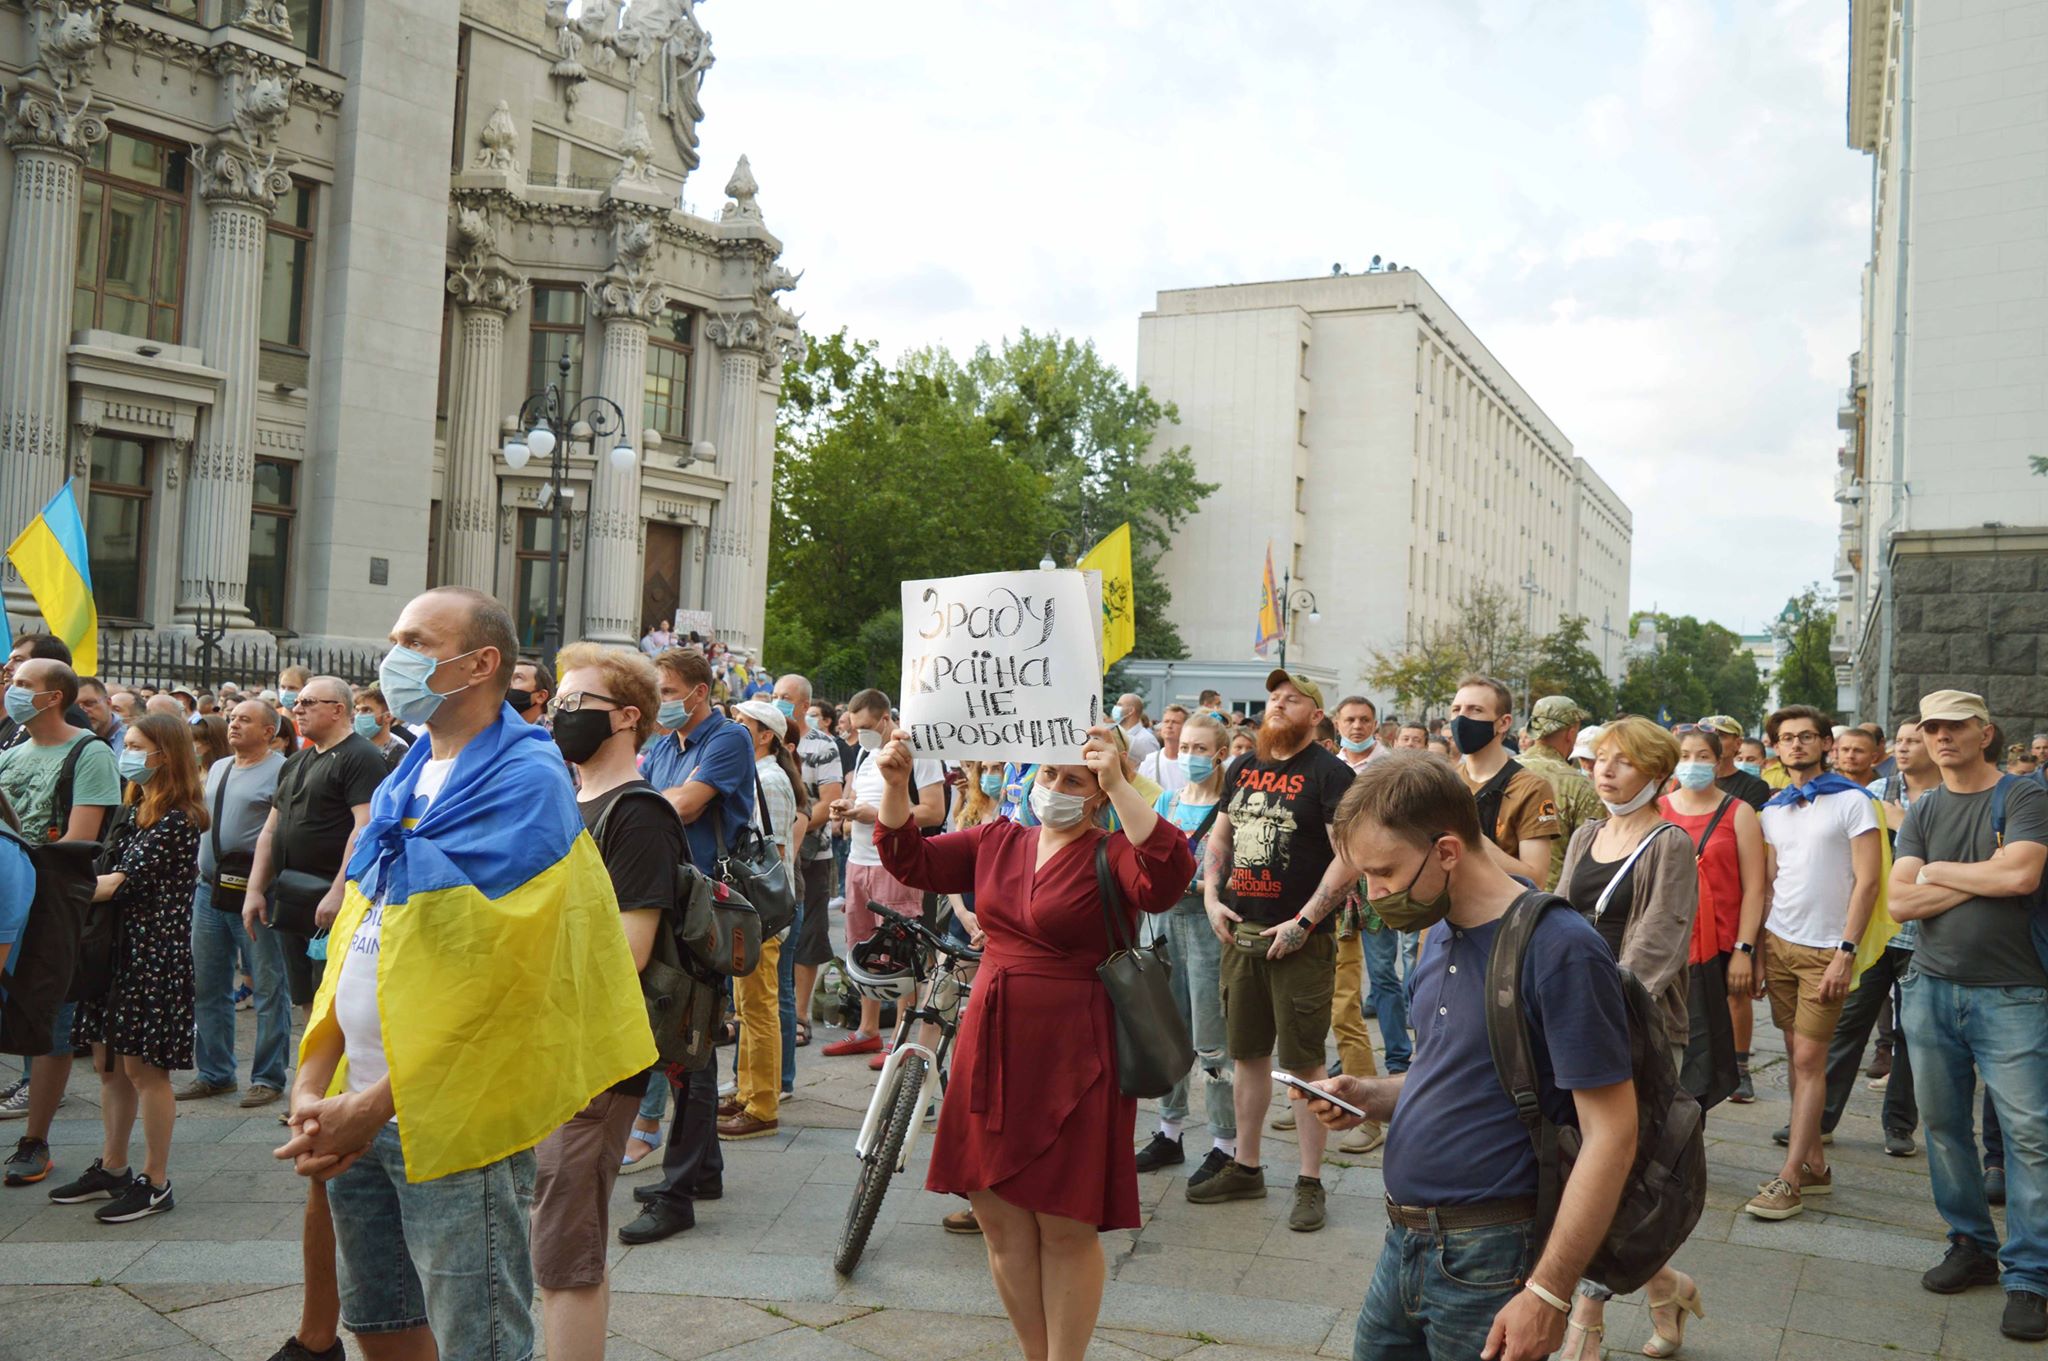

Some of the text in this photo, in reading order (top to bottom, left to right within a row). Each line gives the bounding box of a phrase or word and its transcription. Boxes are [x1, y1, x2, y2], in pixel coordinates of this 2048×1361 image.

[918, 587, 1055, 651] Зраду
[965, 689, 1017, 718] НЕ
[1235, 768, 1305, 794] TARAS
[1261, 868, 1271, 880] &
[351, 934, 381, 955] RAIN
